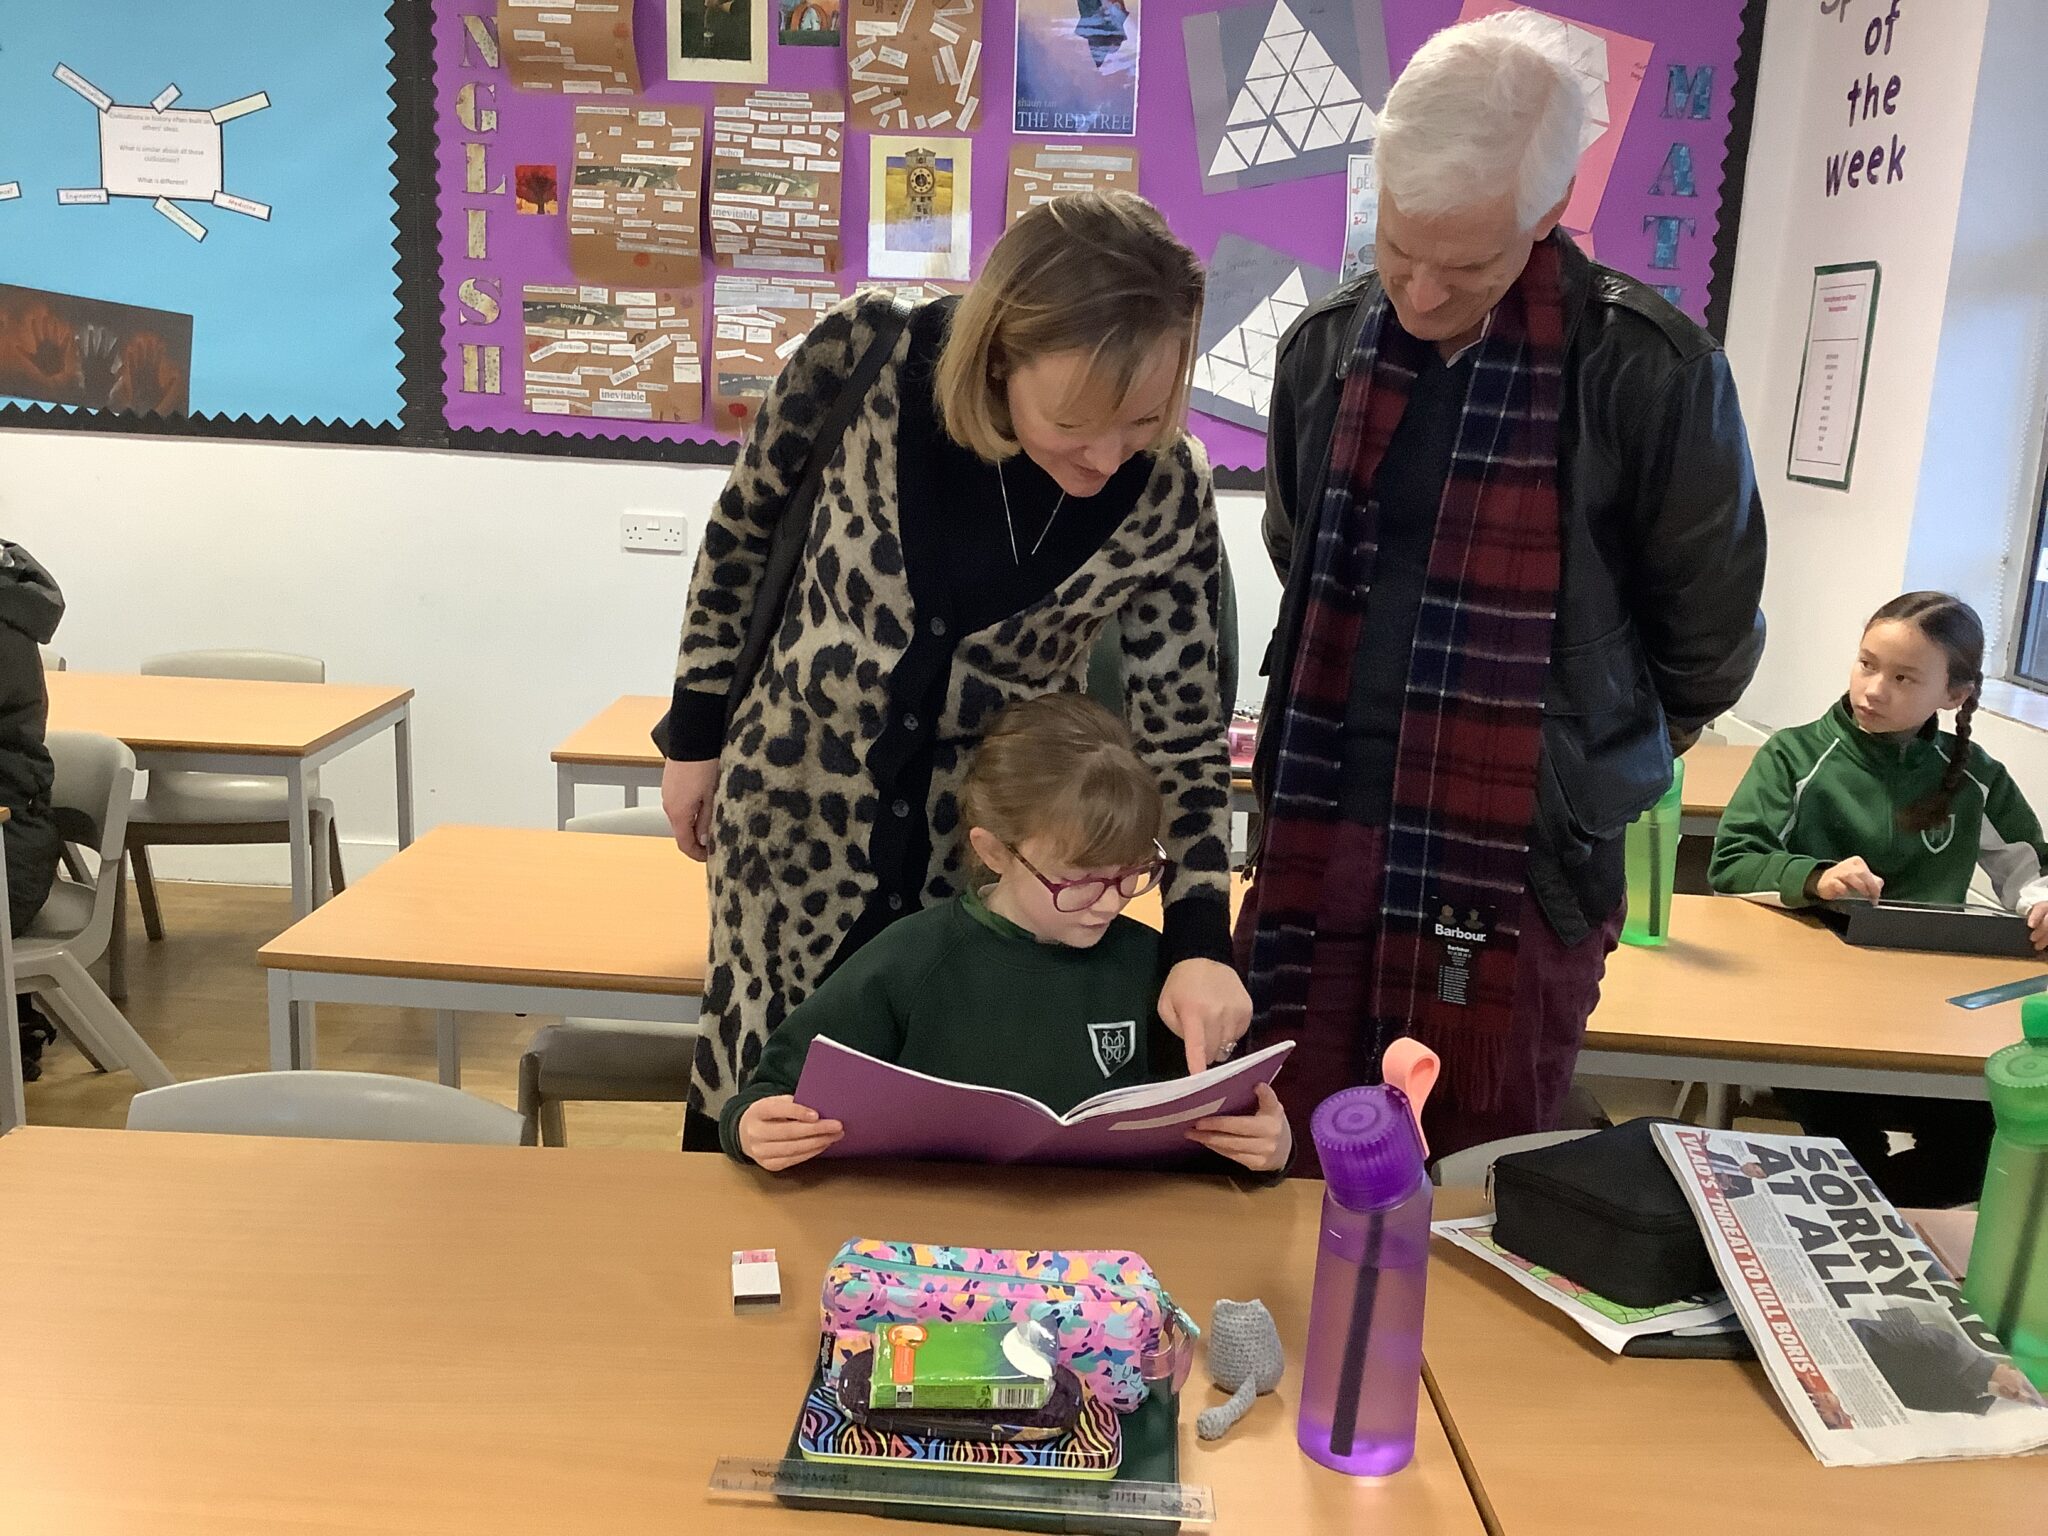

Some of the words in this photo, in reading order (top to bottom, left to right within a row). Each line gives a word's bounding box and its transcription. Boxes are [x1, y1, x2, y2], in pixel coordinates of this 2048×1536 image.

[1847, 72, 1901, 127] the
[1017, 111, 1049, 128] THE
[1054, 112, 1087, 129] RED
[1091, 112, 1131, 130] TREE
[137, 176, 154, 184] What
[1826, 134, 1906, 198] week
[712, 208, 758, 221] inevitable
[613, 370, 632, 383] who
[601, 390, 645, 401] inevitable
[1745, 1141, 1817, 1205] AT
[1785, 1213, 1875, 1309] ALL
[1790, 1145, 1937, 1303] SORRY
[1680, 1135, 1718, 1189] VLAD'S
[1744, 1257, 1761, 1280] TO
[1754, 1281, 1779, 1319] KILL
[1771, 1320, 1818, 1377] BORIS'
